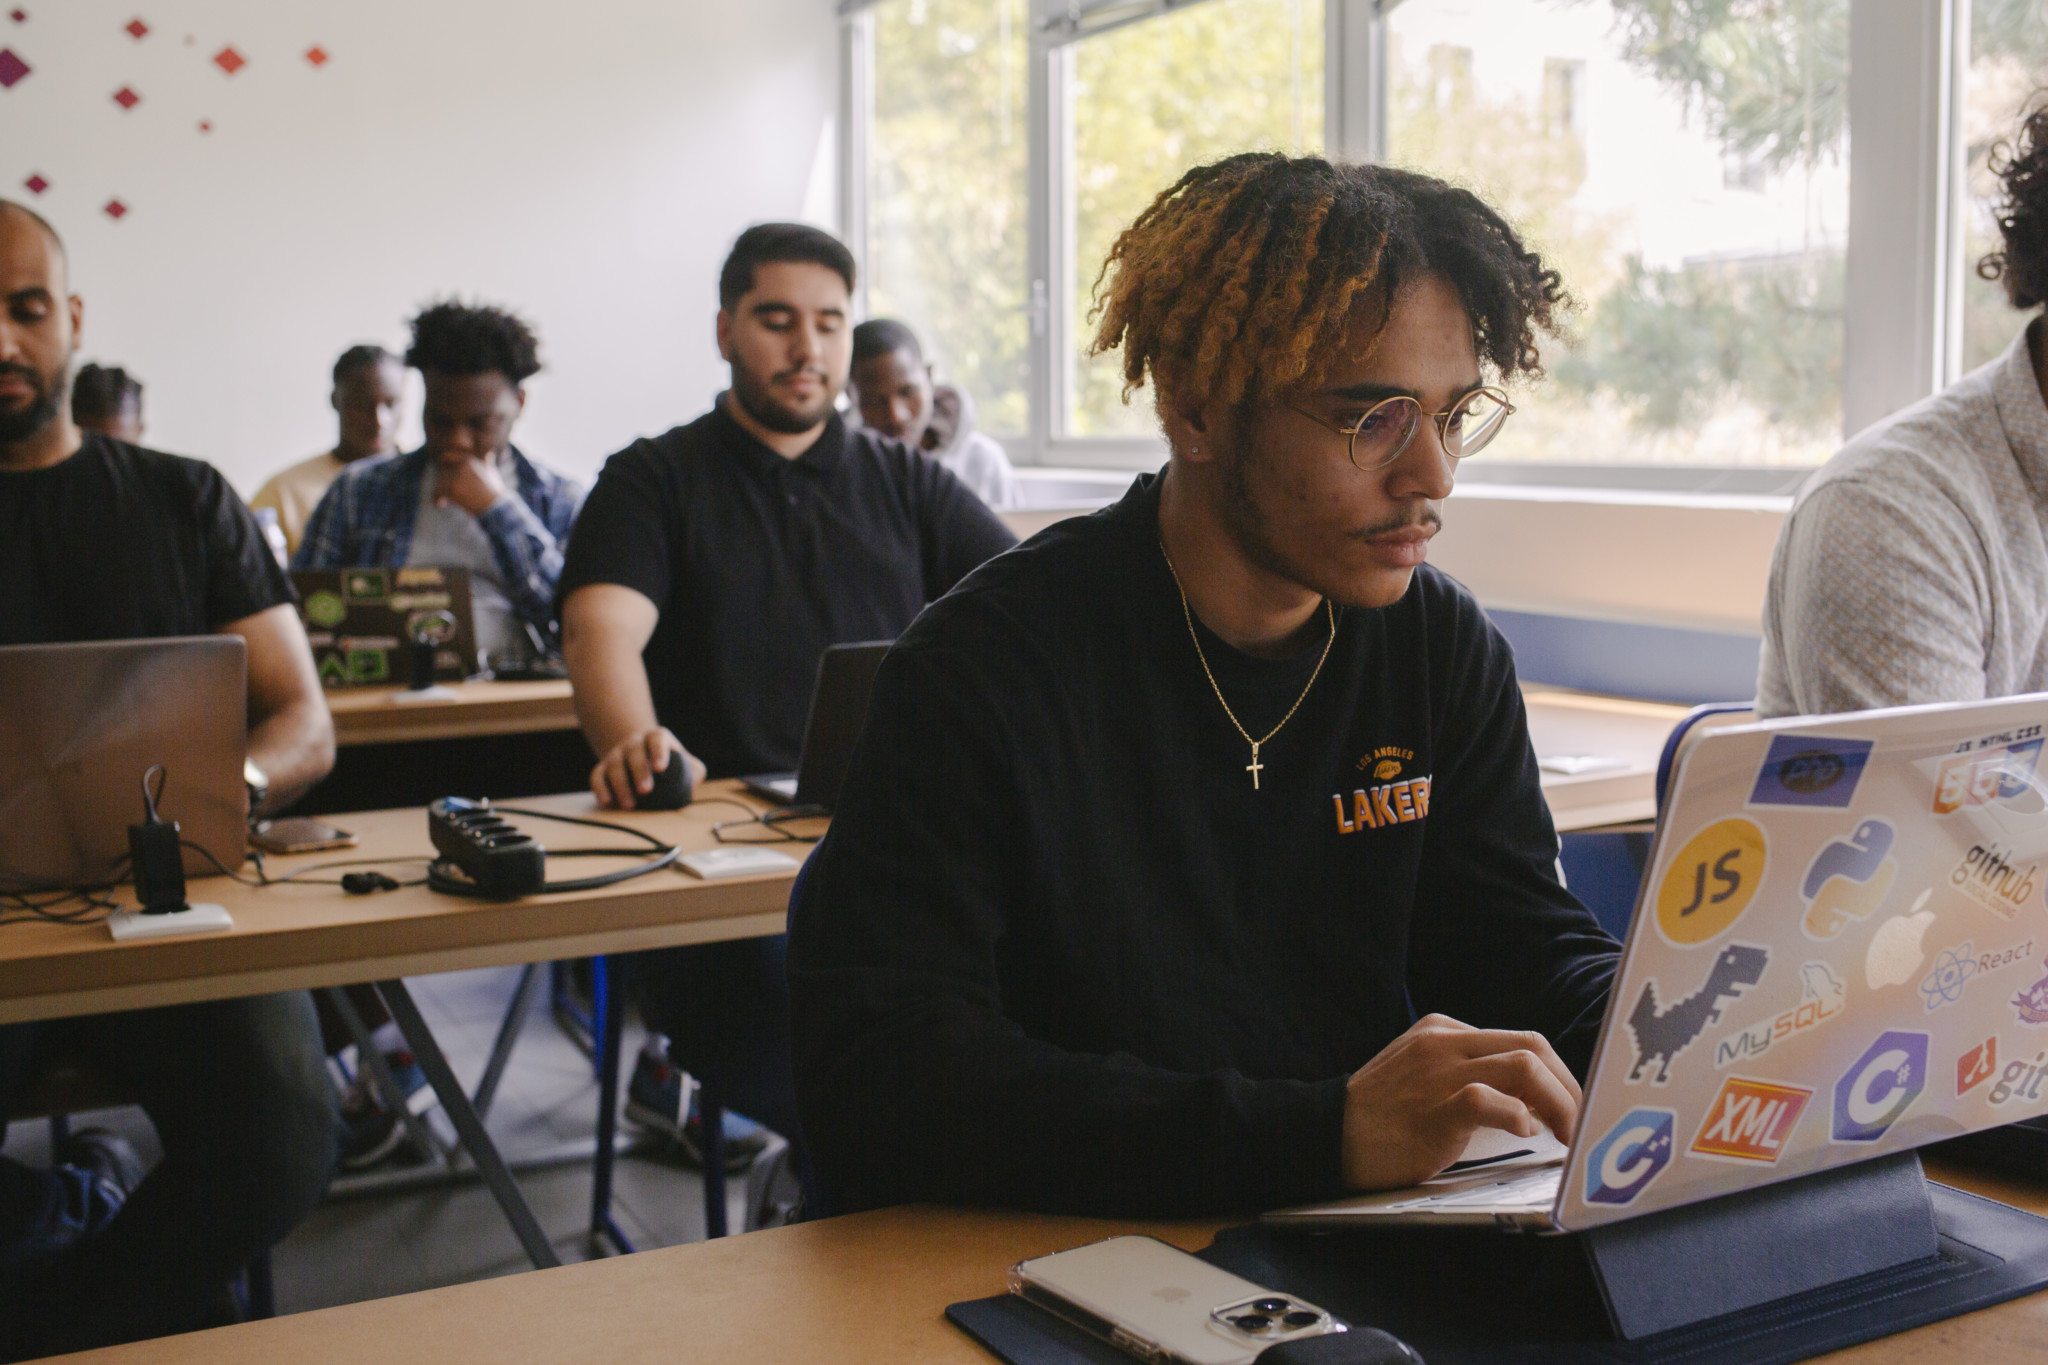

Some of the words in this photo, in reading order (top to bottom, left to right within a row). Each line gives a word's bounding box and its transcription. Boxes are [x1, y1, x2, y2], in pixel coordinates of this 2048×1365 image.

[1356, 753, 1373, 771] LOS
[1374, 746, 1414, 760] ANGELES
[1332, 774, 1432, 834] LAKER
[1681, 848, 1742, 917] JS
[1952, 842, 2036, 905] github
[1977, 940, 2033, 974] React
[1718, 999, 1835, 1064] MySQL
[1847, 1049, 1911, 1125] C#
[1705, 1093, 1789, 1149] XML
[1601, 1126, 1671, 1190] C++
